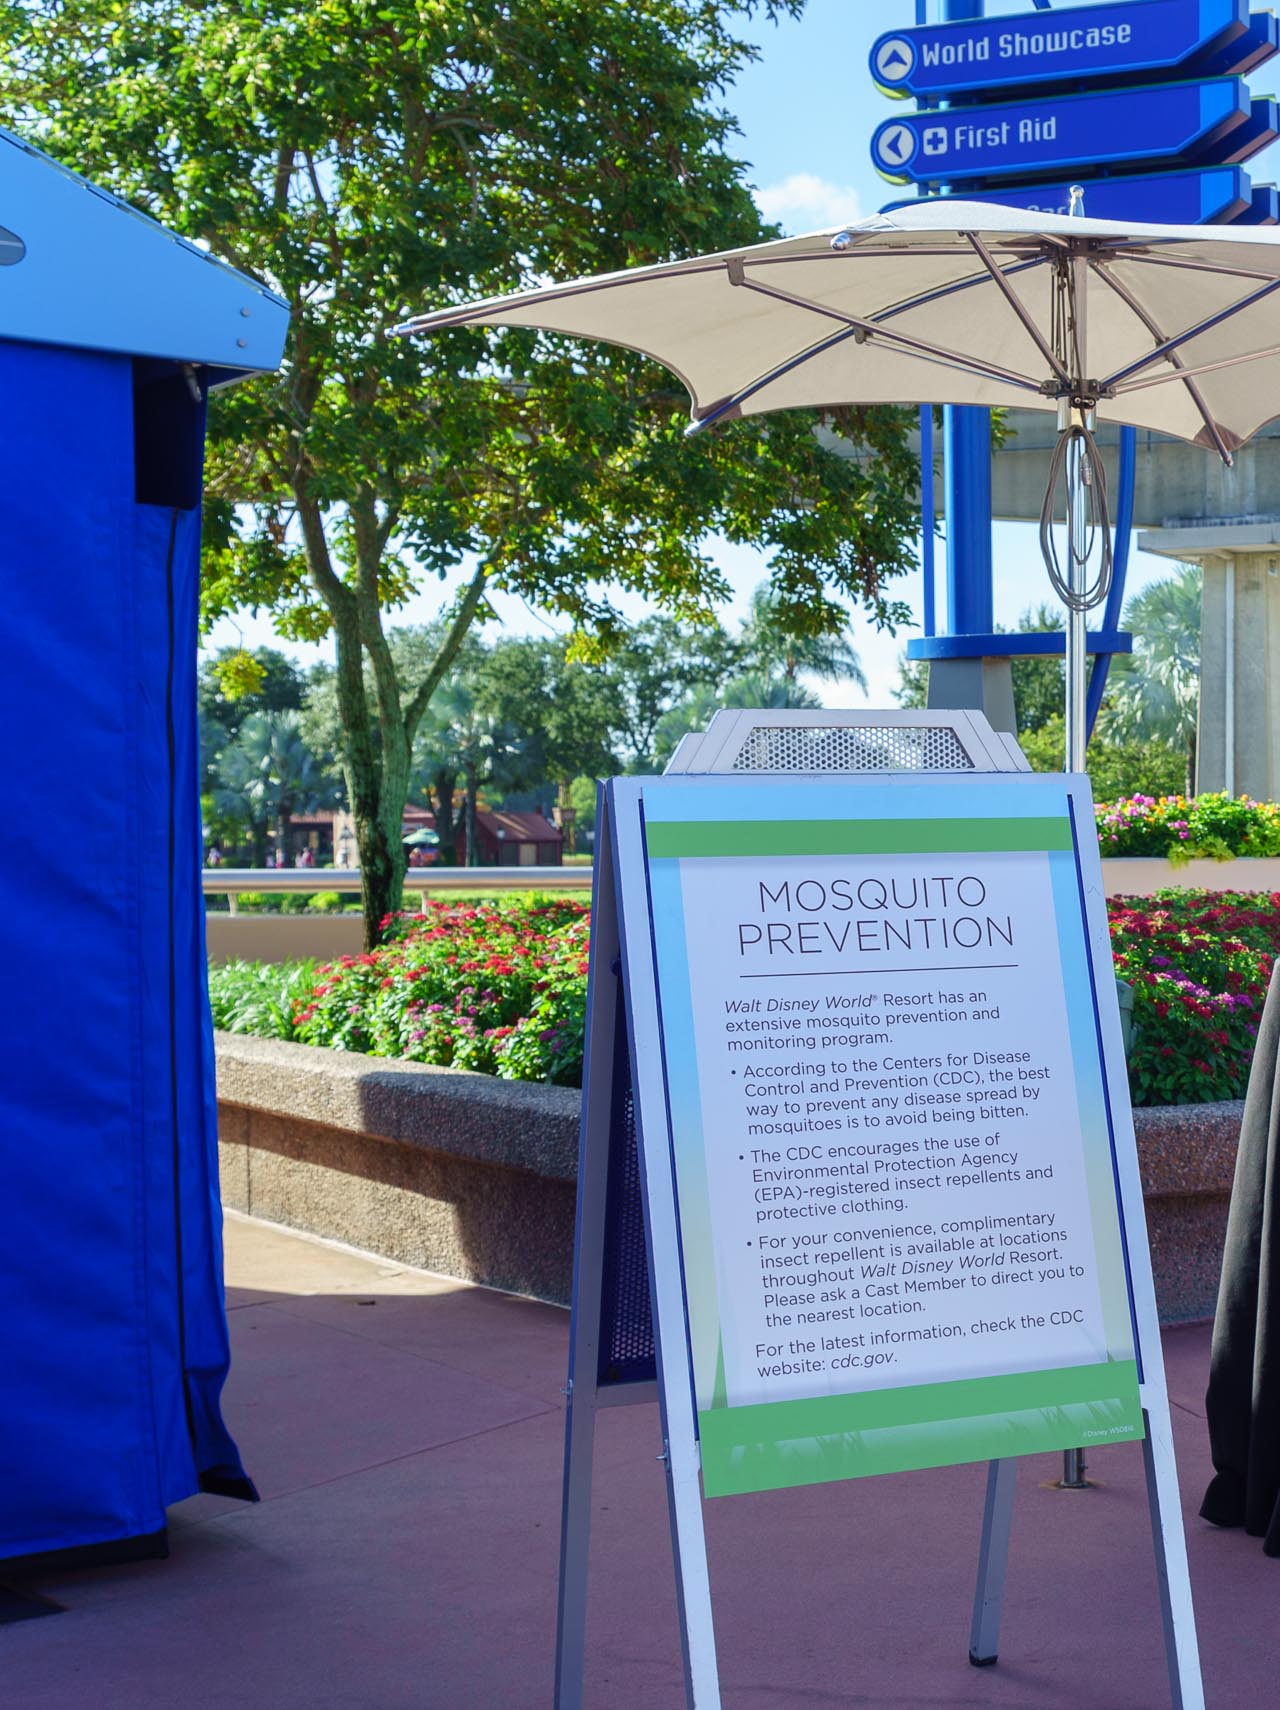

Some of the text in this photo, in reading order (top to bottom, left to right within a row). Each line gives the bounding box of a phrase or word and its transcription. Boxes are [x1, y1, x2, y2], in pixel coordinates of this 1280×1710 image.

[922, 24, 1132, 67] World Showcase
[954, 117, 1057, 150] First Aid
[759, 876, 986, 913] MOSQUITO
[738, 915, 1014, 956] PREVENTION
[724, 998, 762, 1014] Walt
[766, 997, 821, 1013] Disney
[883, 992, 934, 1007] Resort
[938, 990, 965, 1005] has
[968, 991, 987, 1003] an
[725, 1005, 1001, 1033] extensive mosquito prevention and
[727, 1032, 893, 1052] monitoring program.
[743, 1051, 1031, 1079] According to the Centers for Disease
[744, 1066, 1051, 1098] Control and Prevention (CDC), the best
[745, 1084, 1040, 1118] way to prevent any disease spread by
[748, 1105, 1029, 1136] mosquitoes is to avoid being bitten.
[749, 1131, 1001, 1164] The CDC encourages the use of
[752, 1152, 1018, 1183] Environmental Protection Agency
[754, 1164, 1054, 1204] (EPA)-registered insect repellents and
[756, 1197, 909, 1224] protective clothing.
[758, 1212, 1056, 1250] For your convenience, complimentary
[760, 1229, 1068, 1269] insect repellent is available at locations
[761, 1247, 1063, 1289] throughout Walt Disney World Resort.
[764, 1264, 1085, 1309] Please ask a Cast Member to direct you to
[765, 1301, 926, 1328] the nearest location.
[755, 1309, 1085, 1359] For the latest information, check the CDC
[756, 1352, 898, 1378] website: cdc.gov.
